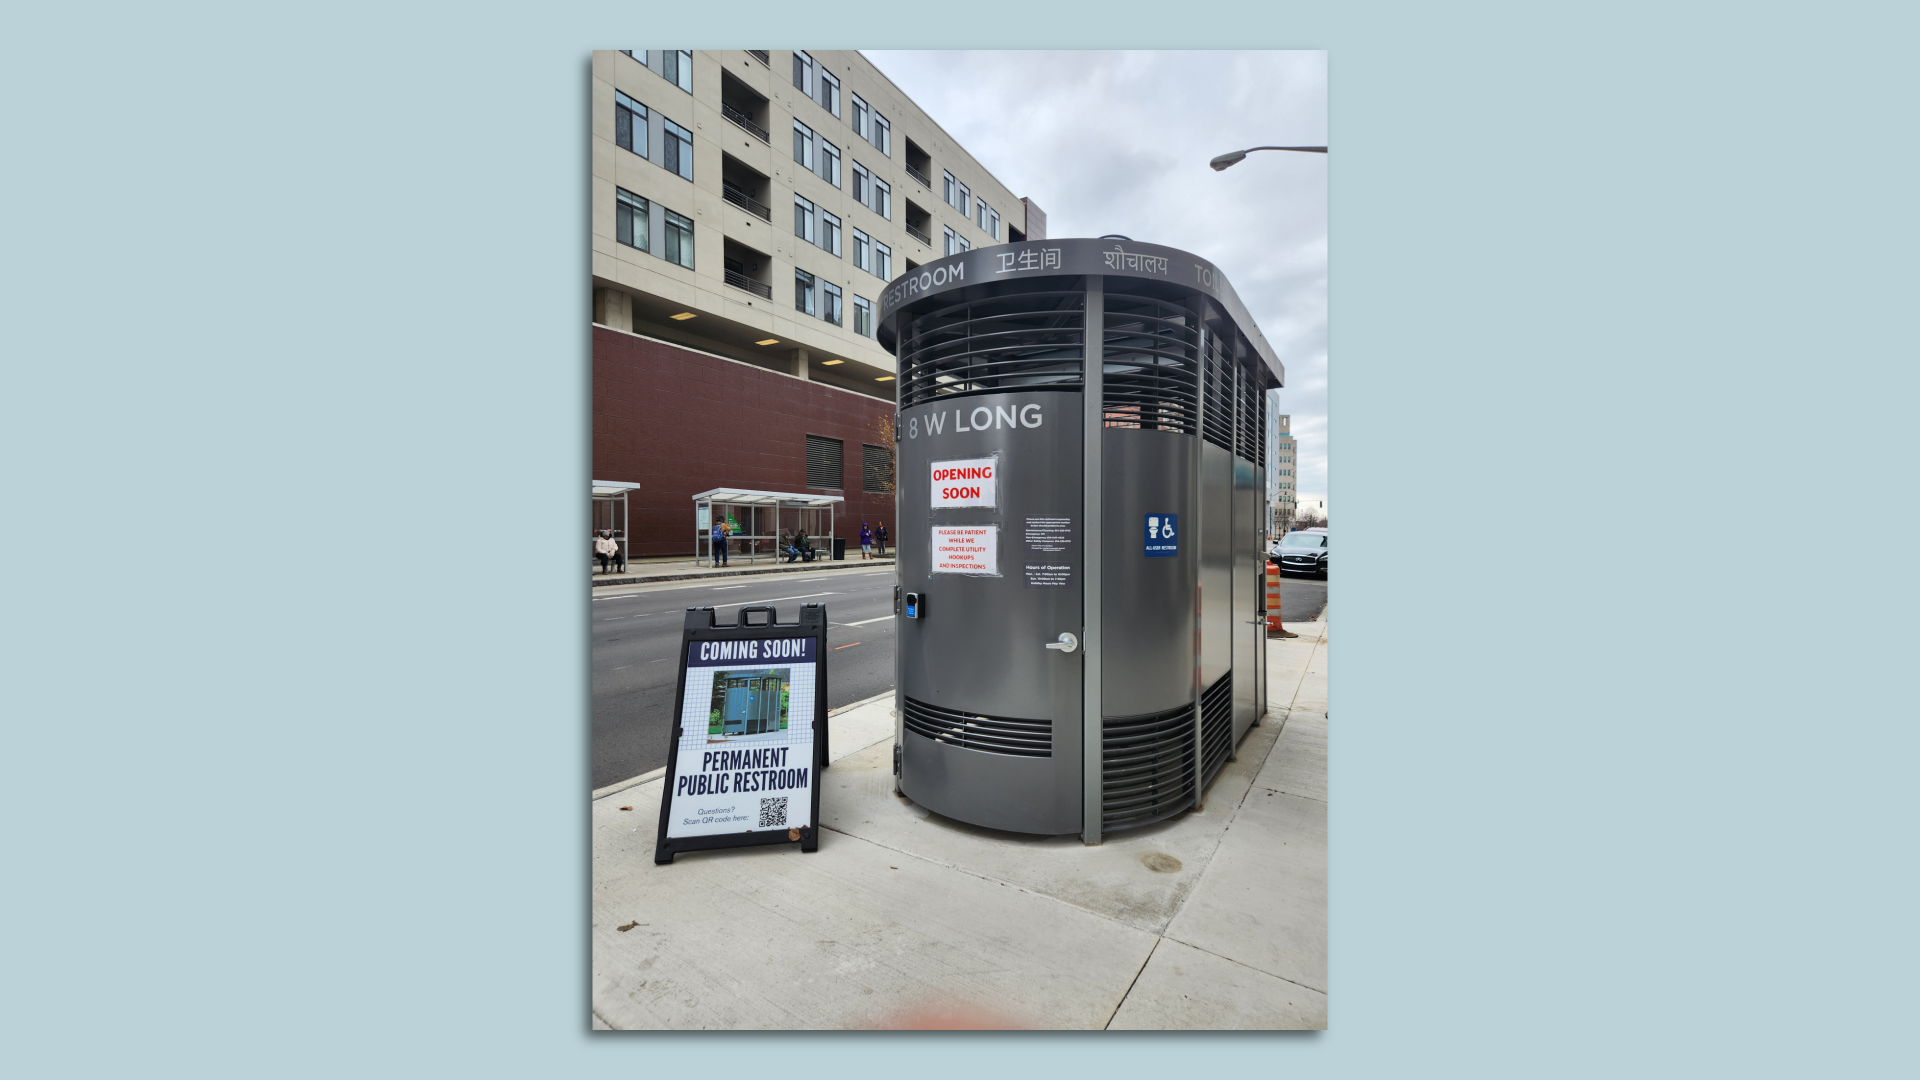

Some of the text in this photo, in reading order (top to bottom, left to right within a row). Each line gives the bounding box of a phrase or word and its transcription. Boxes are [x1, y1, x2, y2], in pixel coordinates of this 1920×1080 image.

[996, 248, 1062, 275] 卫生间
[1103, 245, 1169, 276] शौचालय
[883, 261, 965, 310] RESTROOM
[908, 403, 1043, 440] 8 W LONG
[933, 466, 992, 481] OPENING
[942, 487, 980, 499] SOON
[700, 638, 806, 660] COMING SOON!
[702, 747, 789, 772] PERMANENT
[677, 768, 808, 796] PUBLIC RESTROOM
[698, 806, 735, 816] Questions?
[732, 814, 749, 822] here:
